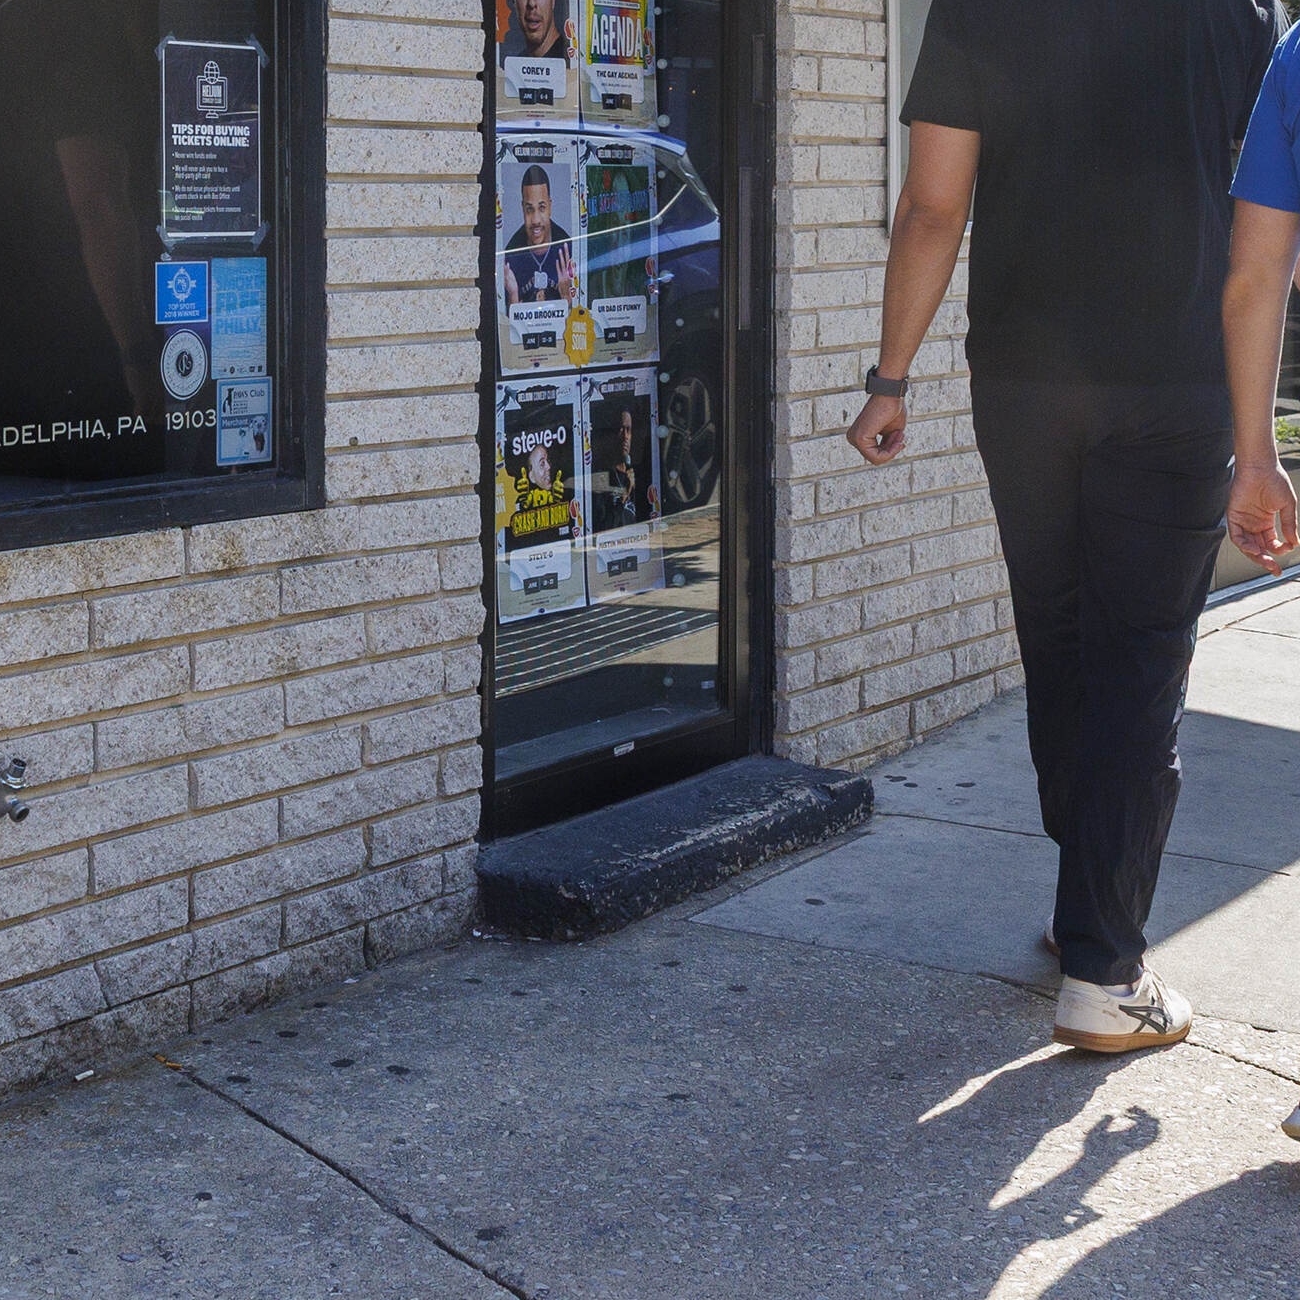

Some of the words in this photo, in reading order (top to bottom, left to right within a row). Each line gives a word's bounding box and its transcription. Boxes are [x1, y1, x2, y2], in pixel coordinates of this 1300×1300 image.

[591, 15, 643, 59] AGENDA
[521, 66, 544, 76] COREY
[172, 124, 194, 134] TIPS
[195, 124, 213, 135] FOR
[215, 125, 250, 136] BUYING
[172, 135, 212, 146] TICKETS
[213, 136, 250, 147] ONLINE:
[617, 304, 623, 312] IS
[513, 311, 533, 320] MOJO
[534, 309, 565, 319] BROOKZZ
[250, 388, 265, 397] Club
[117, 416, 147, 436] PA
[165, 409, 216, 431] 19103
[514, 512, 535, 534] CRASH
[537, 508, 549, 530] AND
[528, 552, 554, 562] STEVE-O
